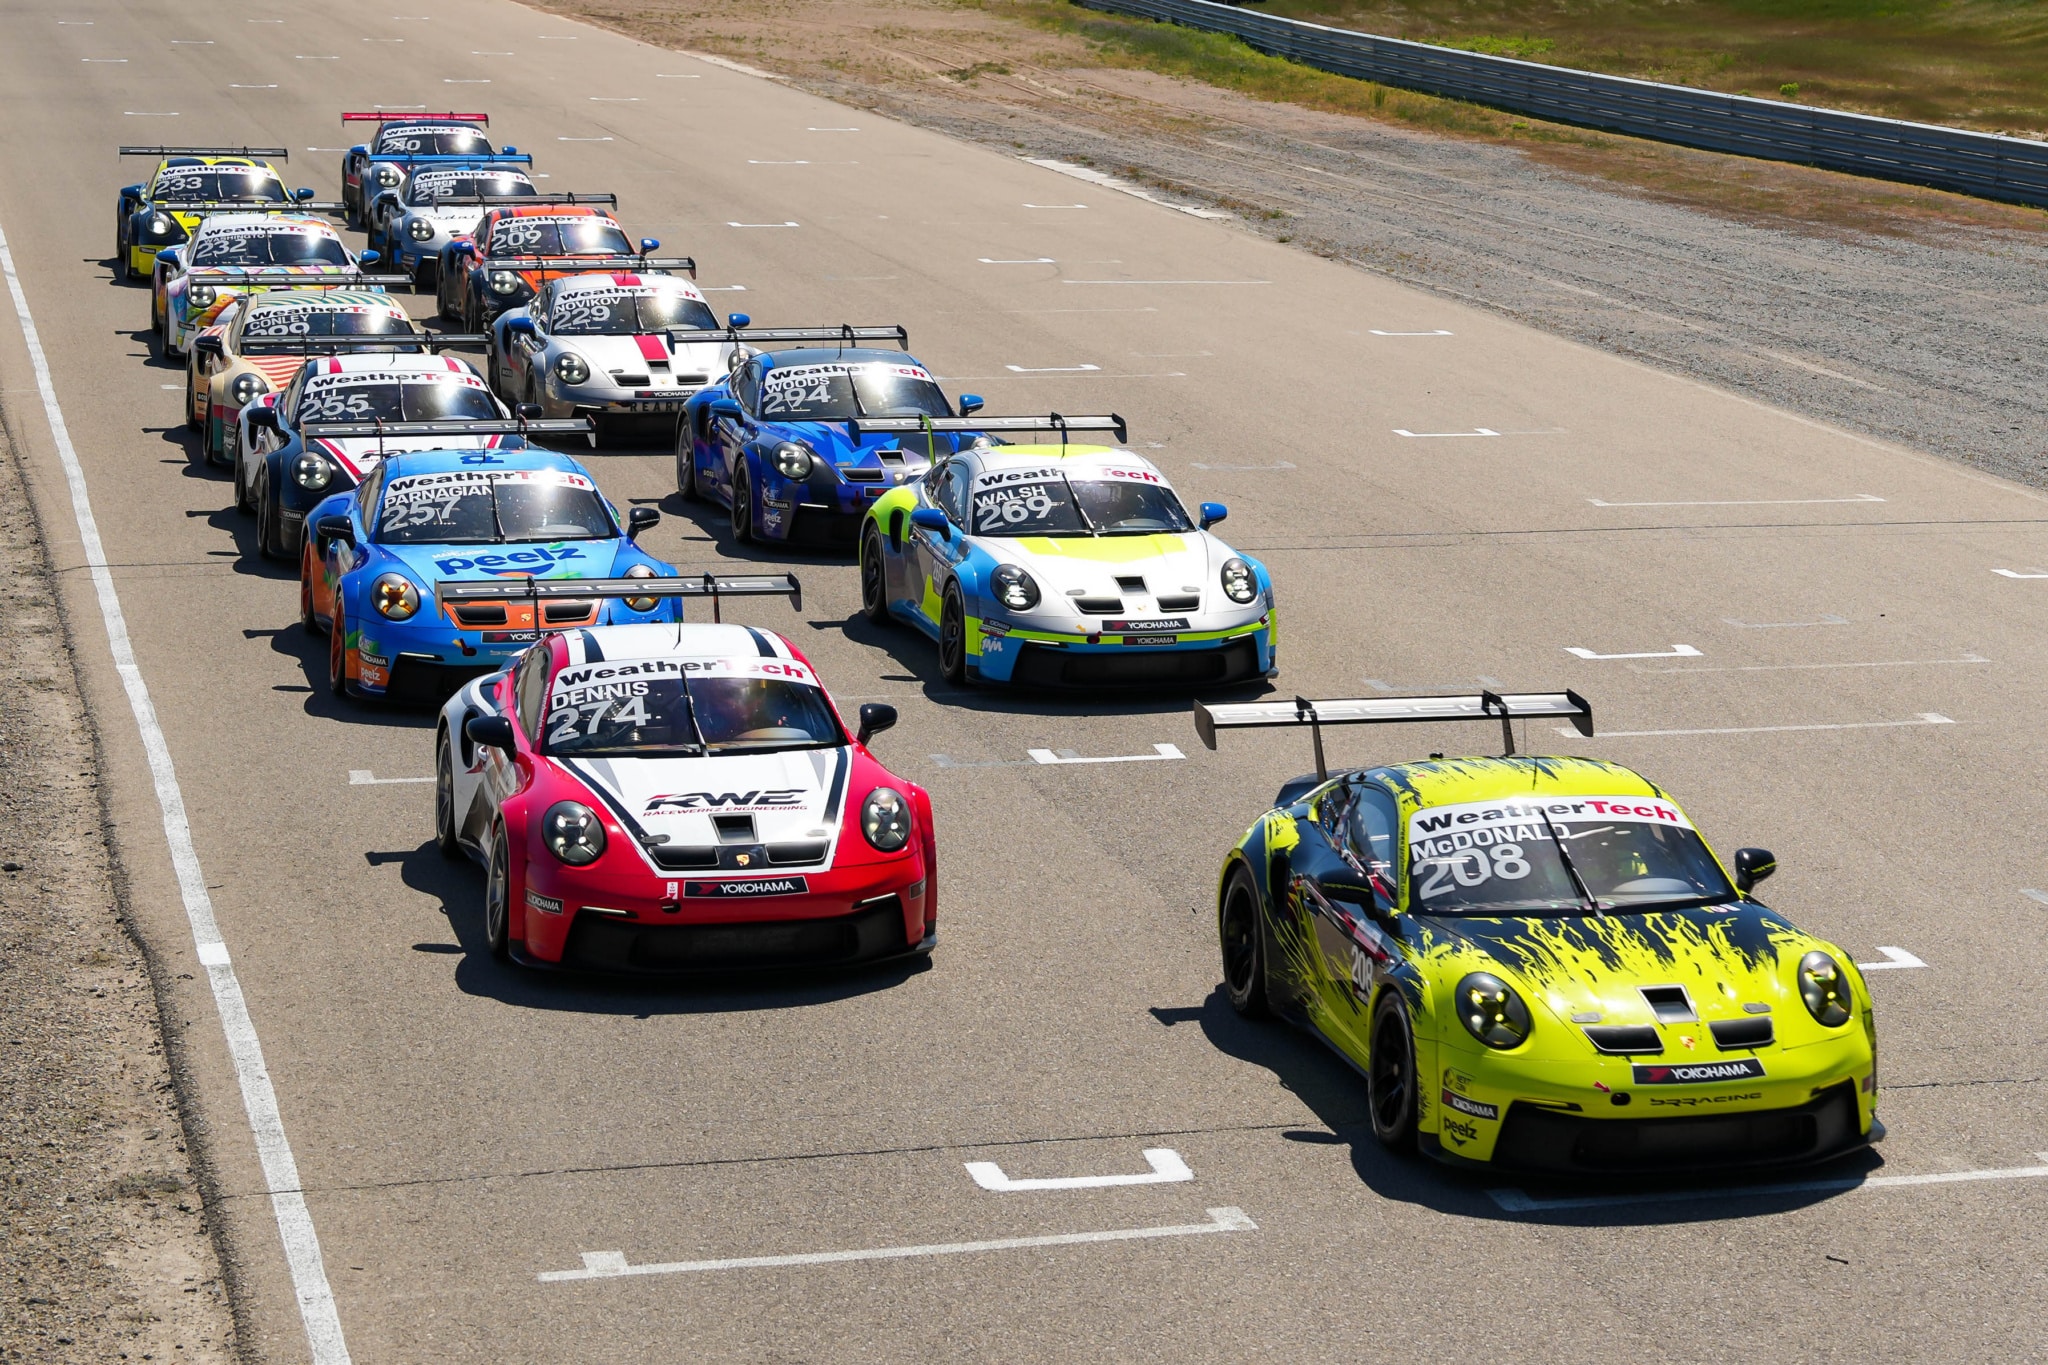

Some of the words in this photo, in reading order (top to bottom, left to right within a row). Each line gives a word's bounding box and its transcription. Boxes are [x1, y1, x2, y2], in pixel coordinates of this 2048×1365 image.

[155, 176, 202, 195] 233
[415, 179, 457, 190] FRENCH
[415, 186, 454, 202] 215
[510, 224, 537, 233] ELY
[196, 238, 247, 259] 232
[491, 230, 542, 251] 209
[555, 297, 621, 314] NOVIKOV
[249, 314, 310, 330] CONLEY
[553, 305, 611, 331] 229
[248, 322, 310, 336] 99
[321, 389, 337, 399] LI
[765, 377, 830, 394] WOODS
[299, 393, 369, 422] 255
[762, 386, 832, 415] 294
[384, 485, 494, 509] PARNAGIAN
[975, 485, 1047, 508] WALSH
[382, 496, 461, 533] 257
[975, 496, 1052, 532] 269
[434, 548, 587, 575] peelz
[1127, 620, 1182, 630] YOKOHAMA
[551, 681, 650, 711] DENNIS
[547, 695, 652, 746] 274
[645, 789, 808, 811] RWE
[725, 804, 809, 813] ENGINEERING
[1410, 823, 1572, 863] McDONALD
[1411, 843, 1532, 901] 208
[719, 881, 795, 895] YOKOHAMA
[1351, 944, 1374, 996] 208
[1670, 1063, 1753, 1080] YOKOHAMA
[1443, 1116, 1478, 1141] peelz
